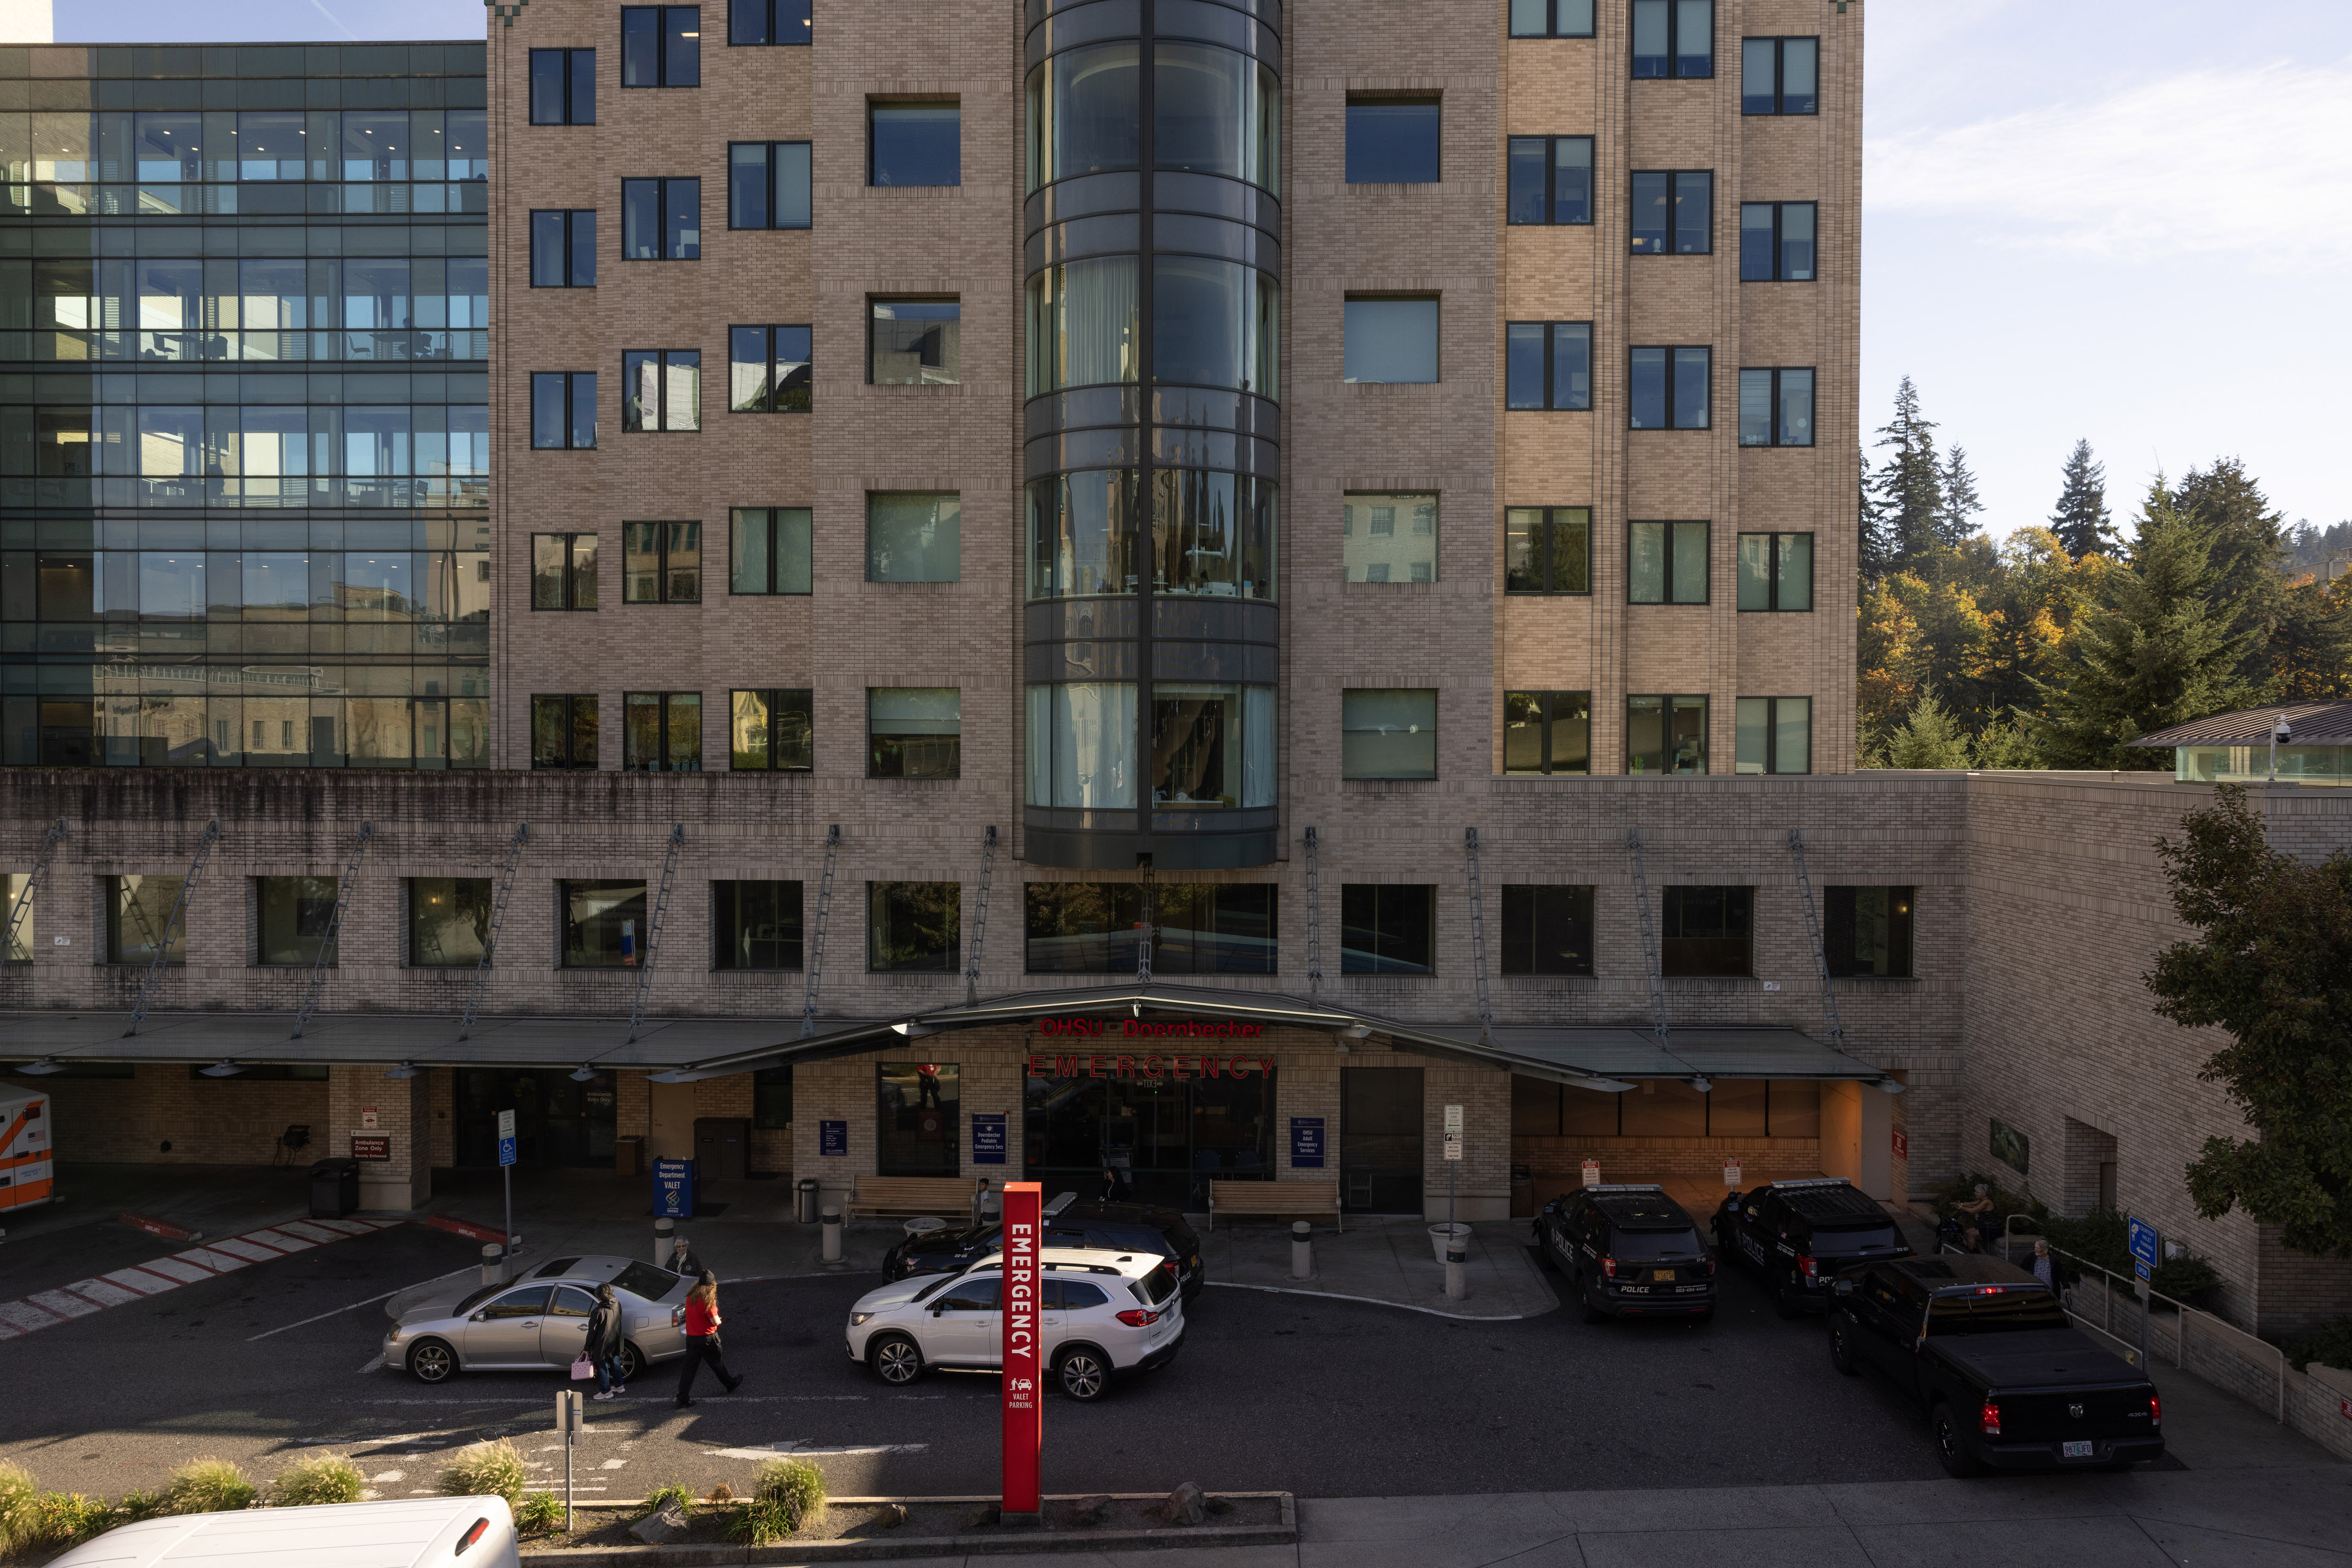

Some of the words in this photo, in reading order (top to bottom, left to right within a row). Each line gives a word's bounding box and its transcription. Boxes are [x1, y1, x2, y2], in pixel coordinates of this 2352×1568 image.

[1040, 1018, 1103, 1037] OHSU
[1124, 1019, 1264, 1037] Doernbecher
[1029, 1054, 1275, 1079] EMERGENCY
[145, 1224, 160, 1233] AMBULANCE
[458, 1228, 476, 1237] AMBULANCE
[2139, 1225, 2155, 1237] COURTESY
[2142, 1234, 2151, 1243] VALET
[1556, 1230, 1574, 1260] POLICE
[1742, 1232, 1764, 1264] POLICE
[2140, 1240, 2153, 1252] PARKING
[1180, 1271, 1191, 1284] POLICE
[2138, 1266, 2148, 1277] OPEN
[1011, 1224, 1032, 1358] EMERGENCY
[2065, 1445, 2076, 1454] 987
[2080, 1444, 2091, 1453] JFD
